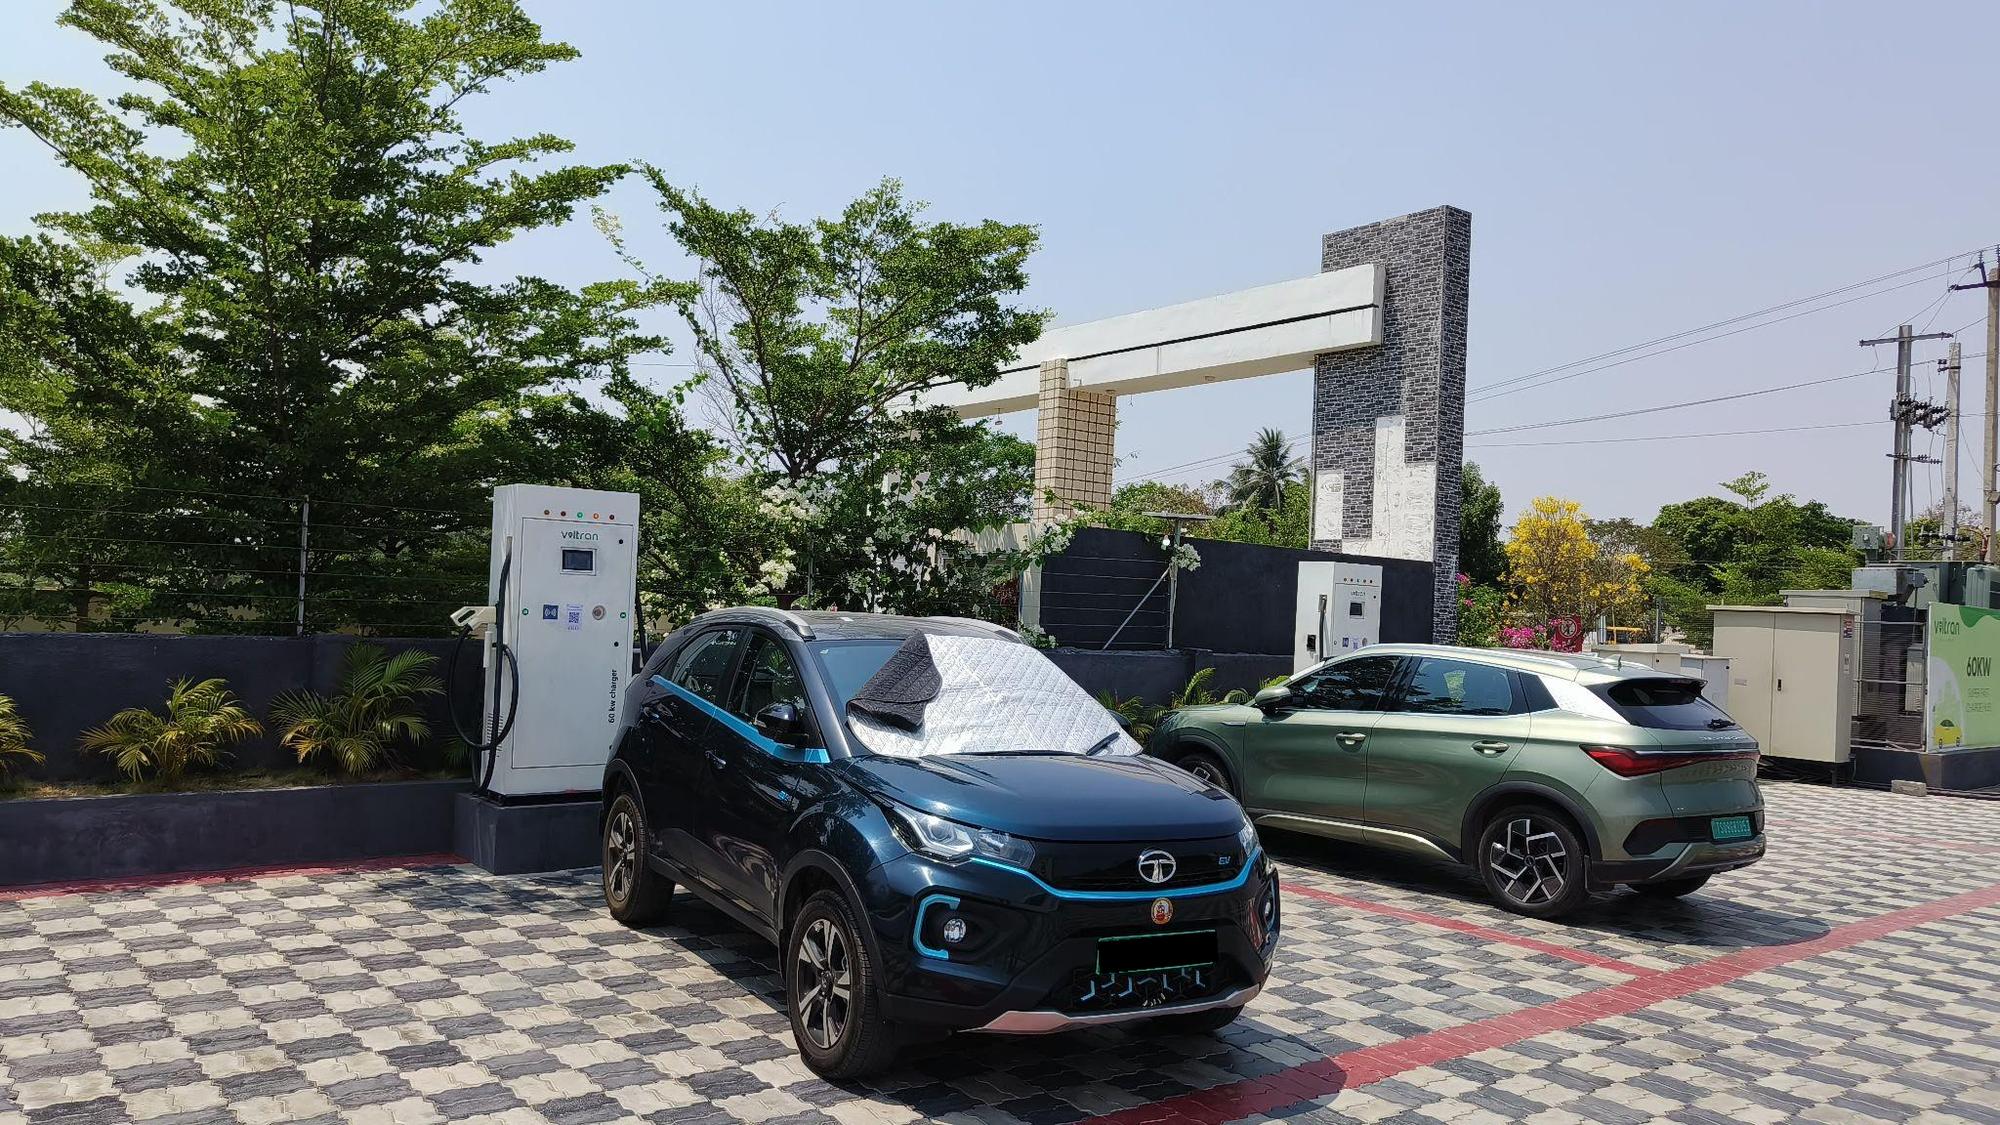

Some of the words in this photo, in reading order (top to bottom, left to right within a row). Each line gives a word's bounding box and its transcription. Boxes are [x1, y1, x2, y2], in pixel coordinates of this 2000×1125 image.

[561, 530, 599, 541] voltran
[1934, 617, 1960, 636] voltran
[1966, 656, 1992, 677] 60KW
[609, 669, 618, 698] charger
[608, 713, 615, 723] 60
[1218, 855, 1231, 865] EV
